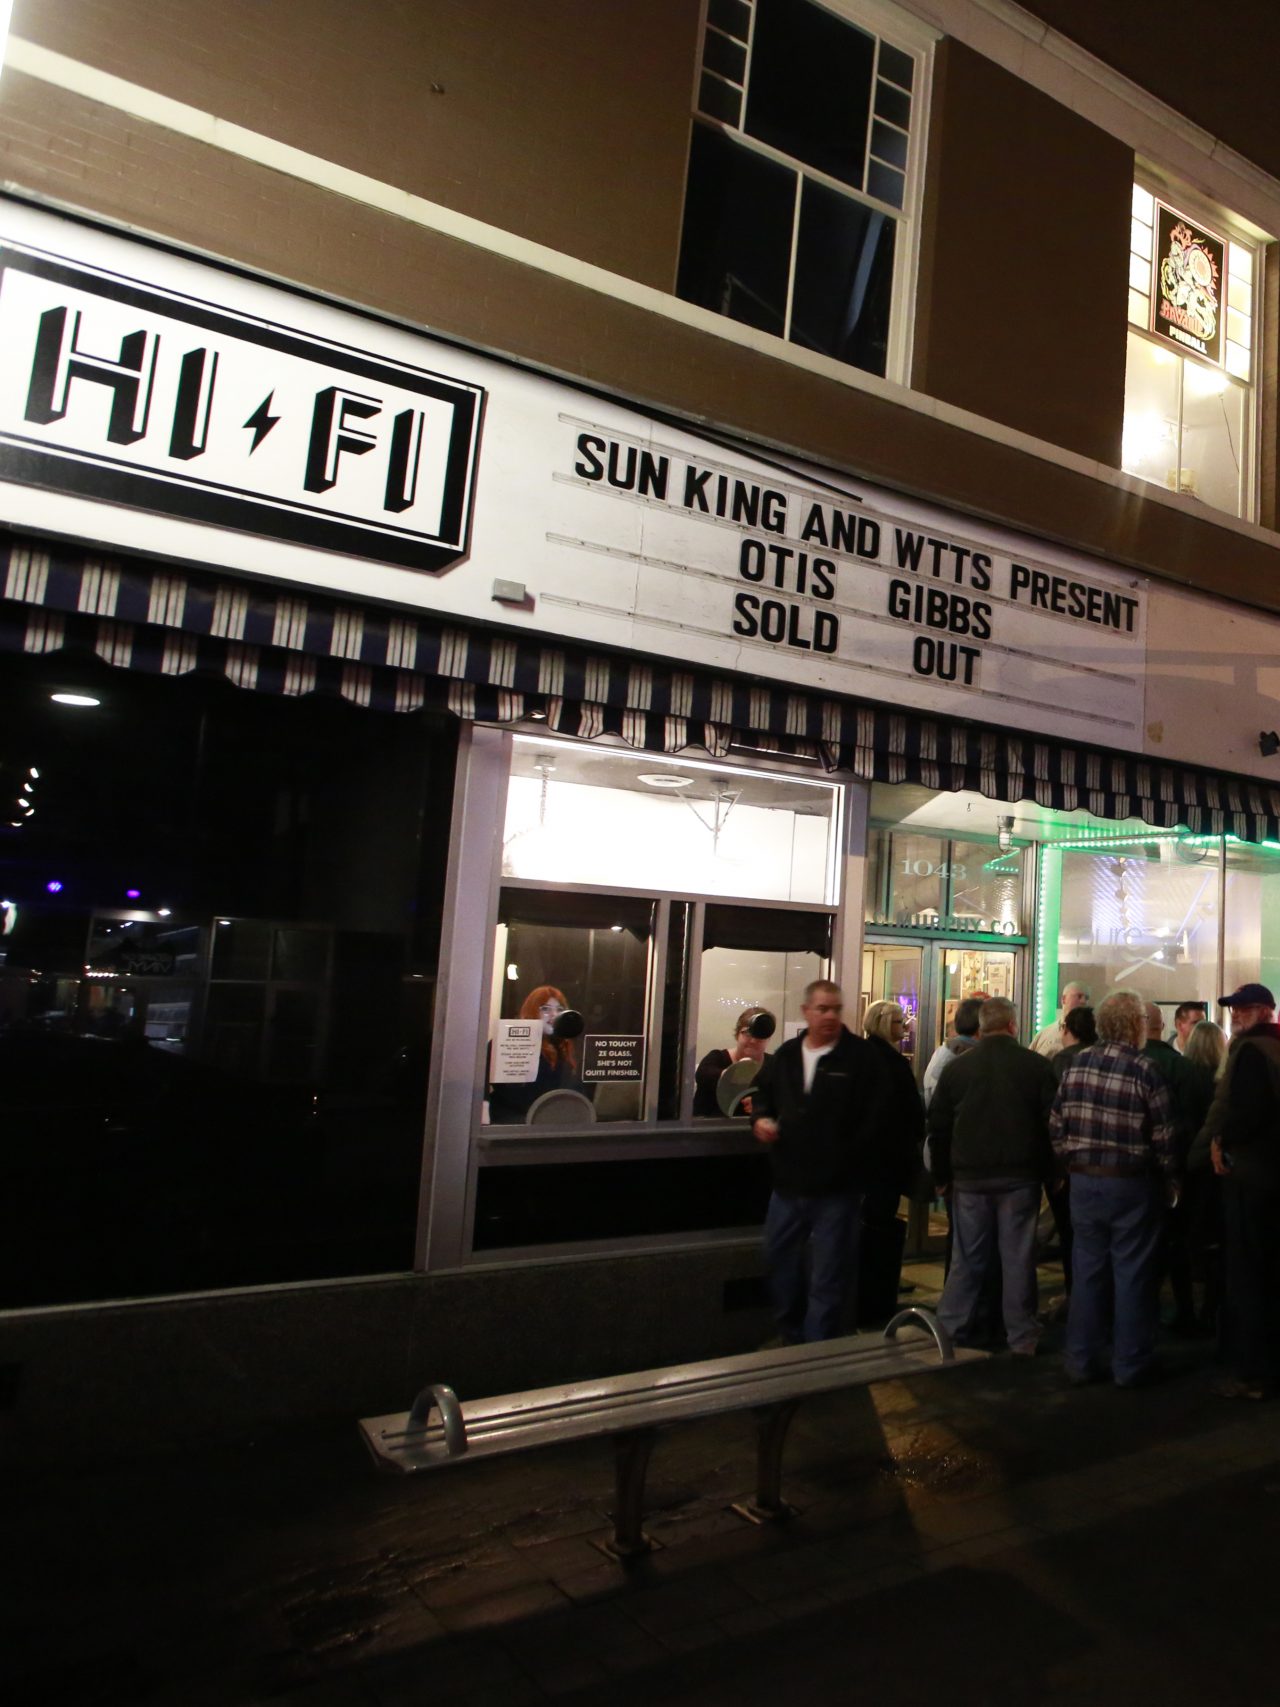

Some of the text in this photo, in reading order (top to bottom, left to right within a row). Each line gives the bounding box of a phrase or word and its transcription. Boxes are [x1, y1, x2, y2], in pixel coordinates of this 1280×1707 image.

[575, 434, 1139, 633] SUN KING AND WTTS PRESENT
[739, 539, 993, 640] OTIS GIBBS
[732, 593, 981, 685] SOLD OUT
[901, 859, 966, 880] 1043
